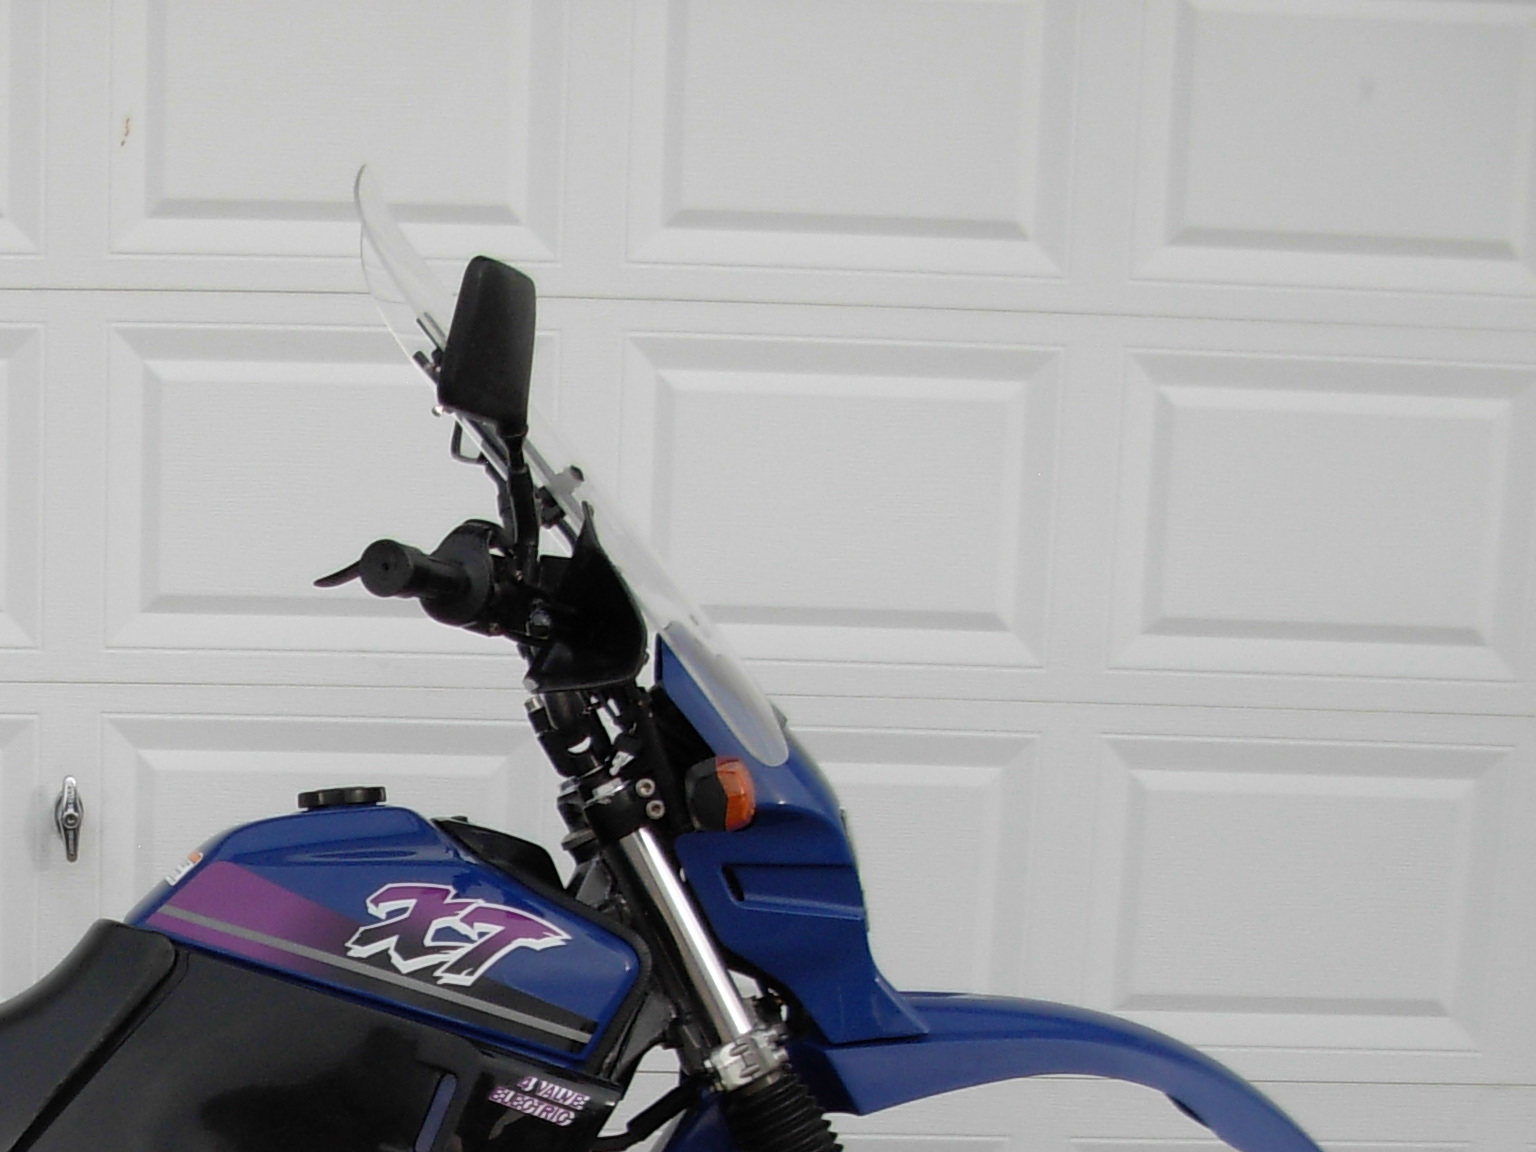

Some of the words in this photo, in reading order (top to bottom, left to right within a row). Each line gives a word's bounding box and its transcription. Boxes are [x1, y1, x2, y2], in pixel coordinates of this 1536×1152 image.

[345, 882, 572, 986] XT
[488, 1086, 576, 1127] ELECTRIC
[535, 1080, 591, 1112] VALVE
